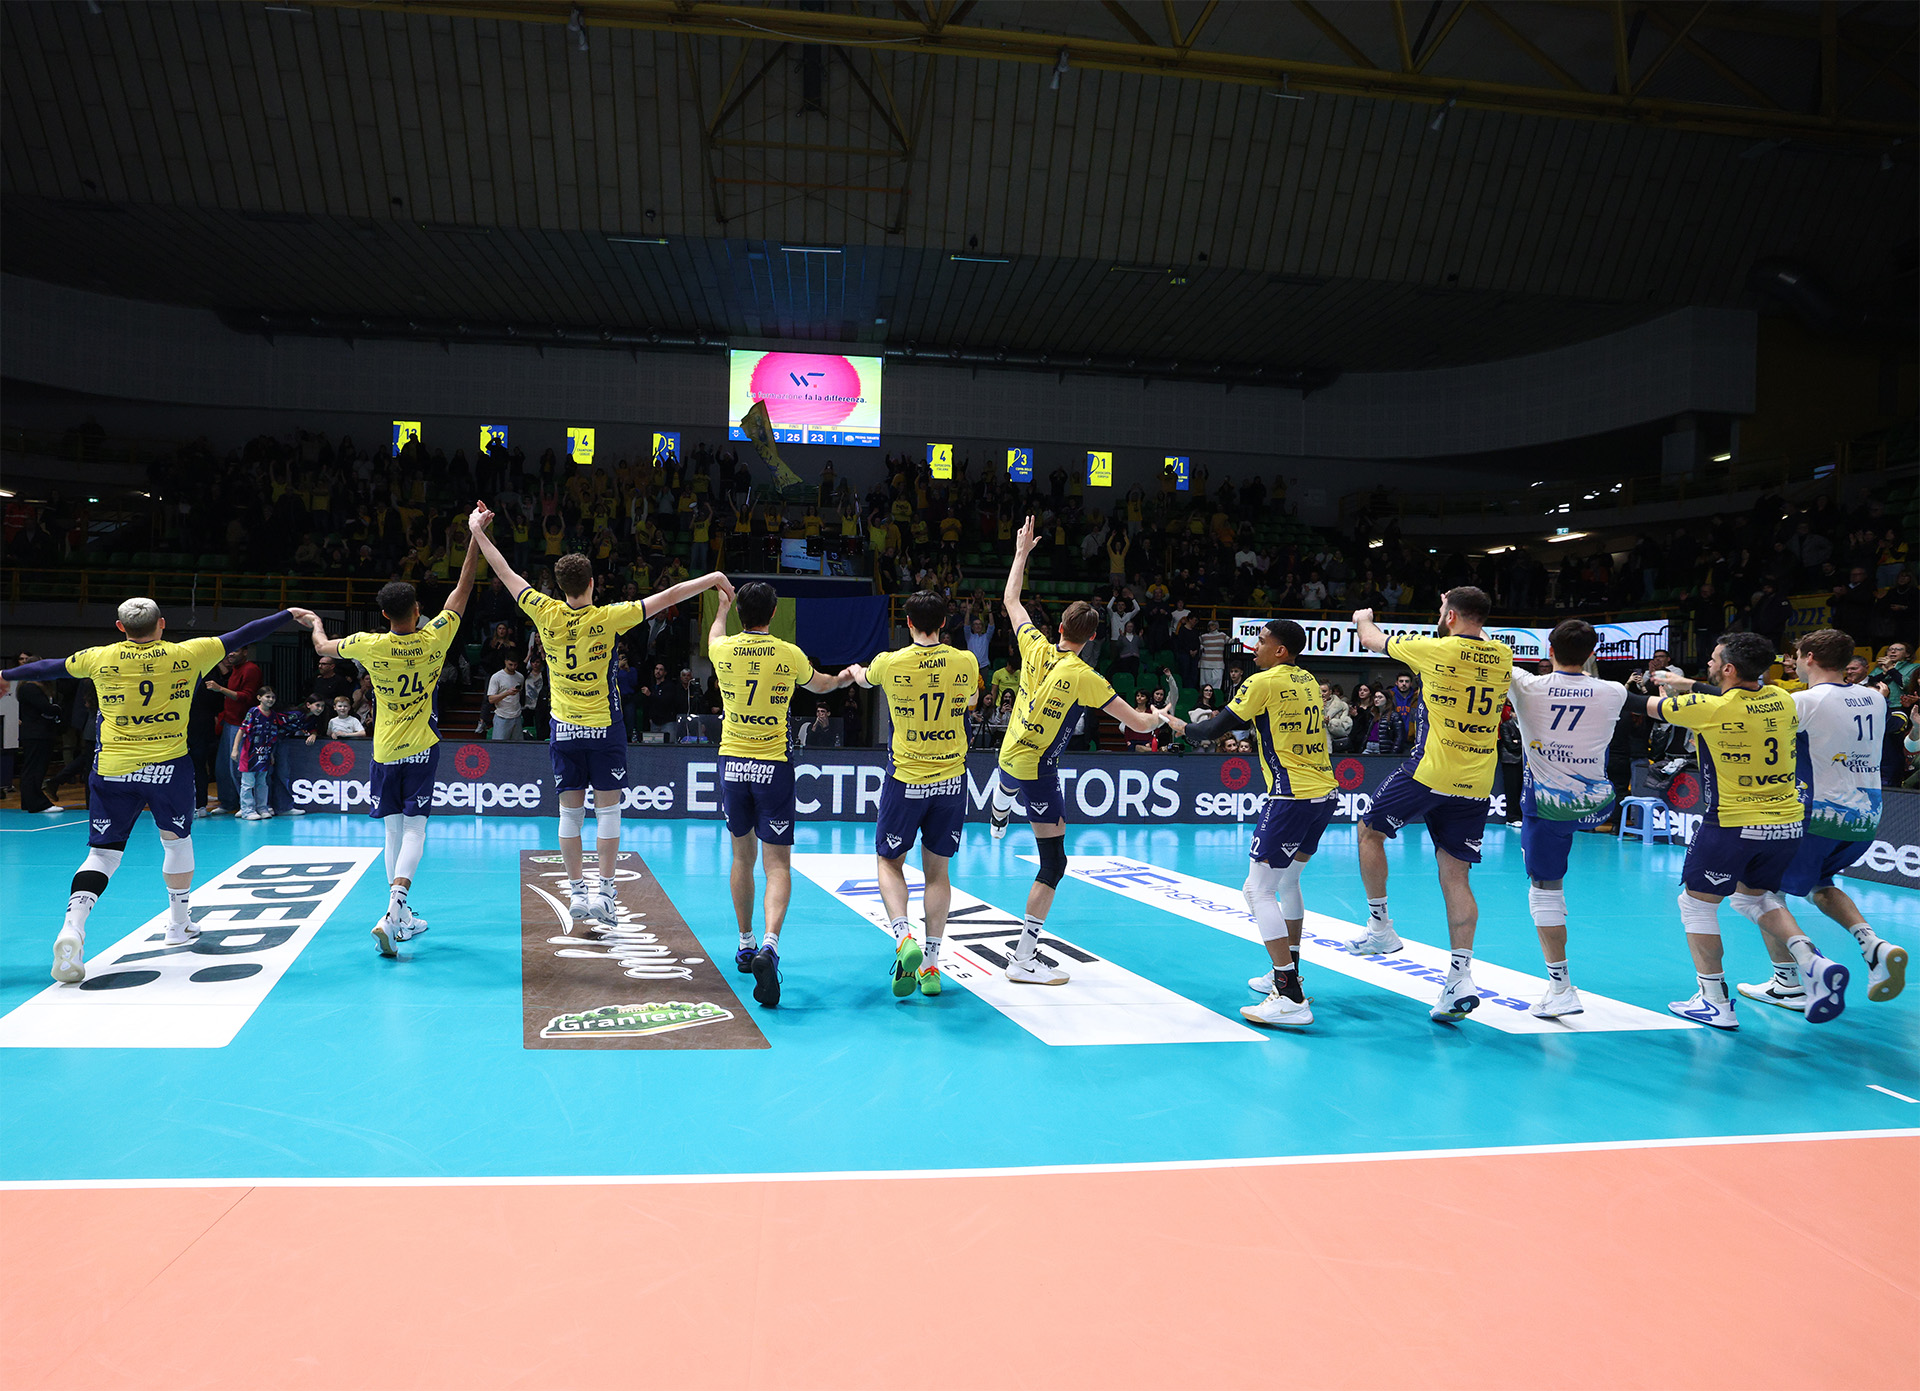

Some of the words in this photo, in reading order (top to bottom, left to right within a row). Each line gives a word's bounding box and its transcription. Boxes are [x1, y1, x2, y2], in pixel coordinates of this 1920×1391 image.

[746, 391, 757, 399] La
[758, 391, 803, 400] formazione
[804, 393, 813, 401] fa
[814, 393, 823, 401] la
[824, 394, 868, 404] differenza.
[582, 434, 589, 446] 4
[667, 438, 675, 450] 5
[787, 433, 800, 442] 25
[811, 433, 824, 442] 23
[832, 434, 837, 443] 1
[940, 450, 946, 462] 4
[1020, 454, 1027, 466] 3
[1101, 458, 1106, 469] 1
[1178, 462, 1184, 474] 1
[1240, 625, 1263, 637] TECN
[1306, 627, 1341, 652] TCP
[565, 645, 577, 670] 5
[733, 646, 776, 657] STANKOVIC
[1460, 650, 1471, 662] DE
[172, 660, 190, 670] AD
[775, 663, 790, 672] AD
[918, 658, 946, 669] ANZANI
[955, 673, 968, 683] AD
[1055, 679, 1071, 690] AD
[397, 672, 425, 698] 24
[139, 680, 154, 706] 9
[745, 679, 758, 706] 7
[1548, 687, 1594, 698] FEDERICI
[919, 692, 945, 722] 17
[1465, 685, 1495, 716] 15
[1844, 695, 1874, 708] GOLLINI
[1042, 707, 1062, 720] USCO
[1745, 700, 1785, 715] MASSARI
[1304, 705, 1320, 735] 22
[1550, 704, 1586, 732] 77
[1853, 713, 1874, 741] 11
[1764, 737, 1778, 766] 3
[1547, 755, 1599, 765] Cimone
[725, 760, 775, 774] modena
[737, 772, 773, 785] nastri
[965, 768, 1180, 824] MTORS
[1704, 869, 1732, 878] VILLANI
[558, 1006, 714, 1032] GranTerre
